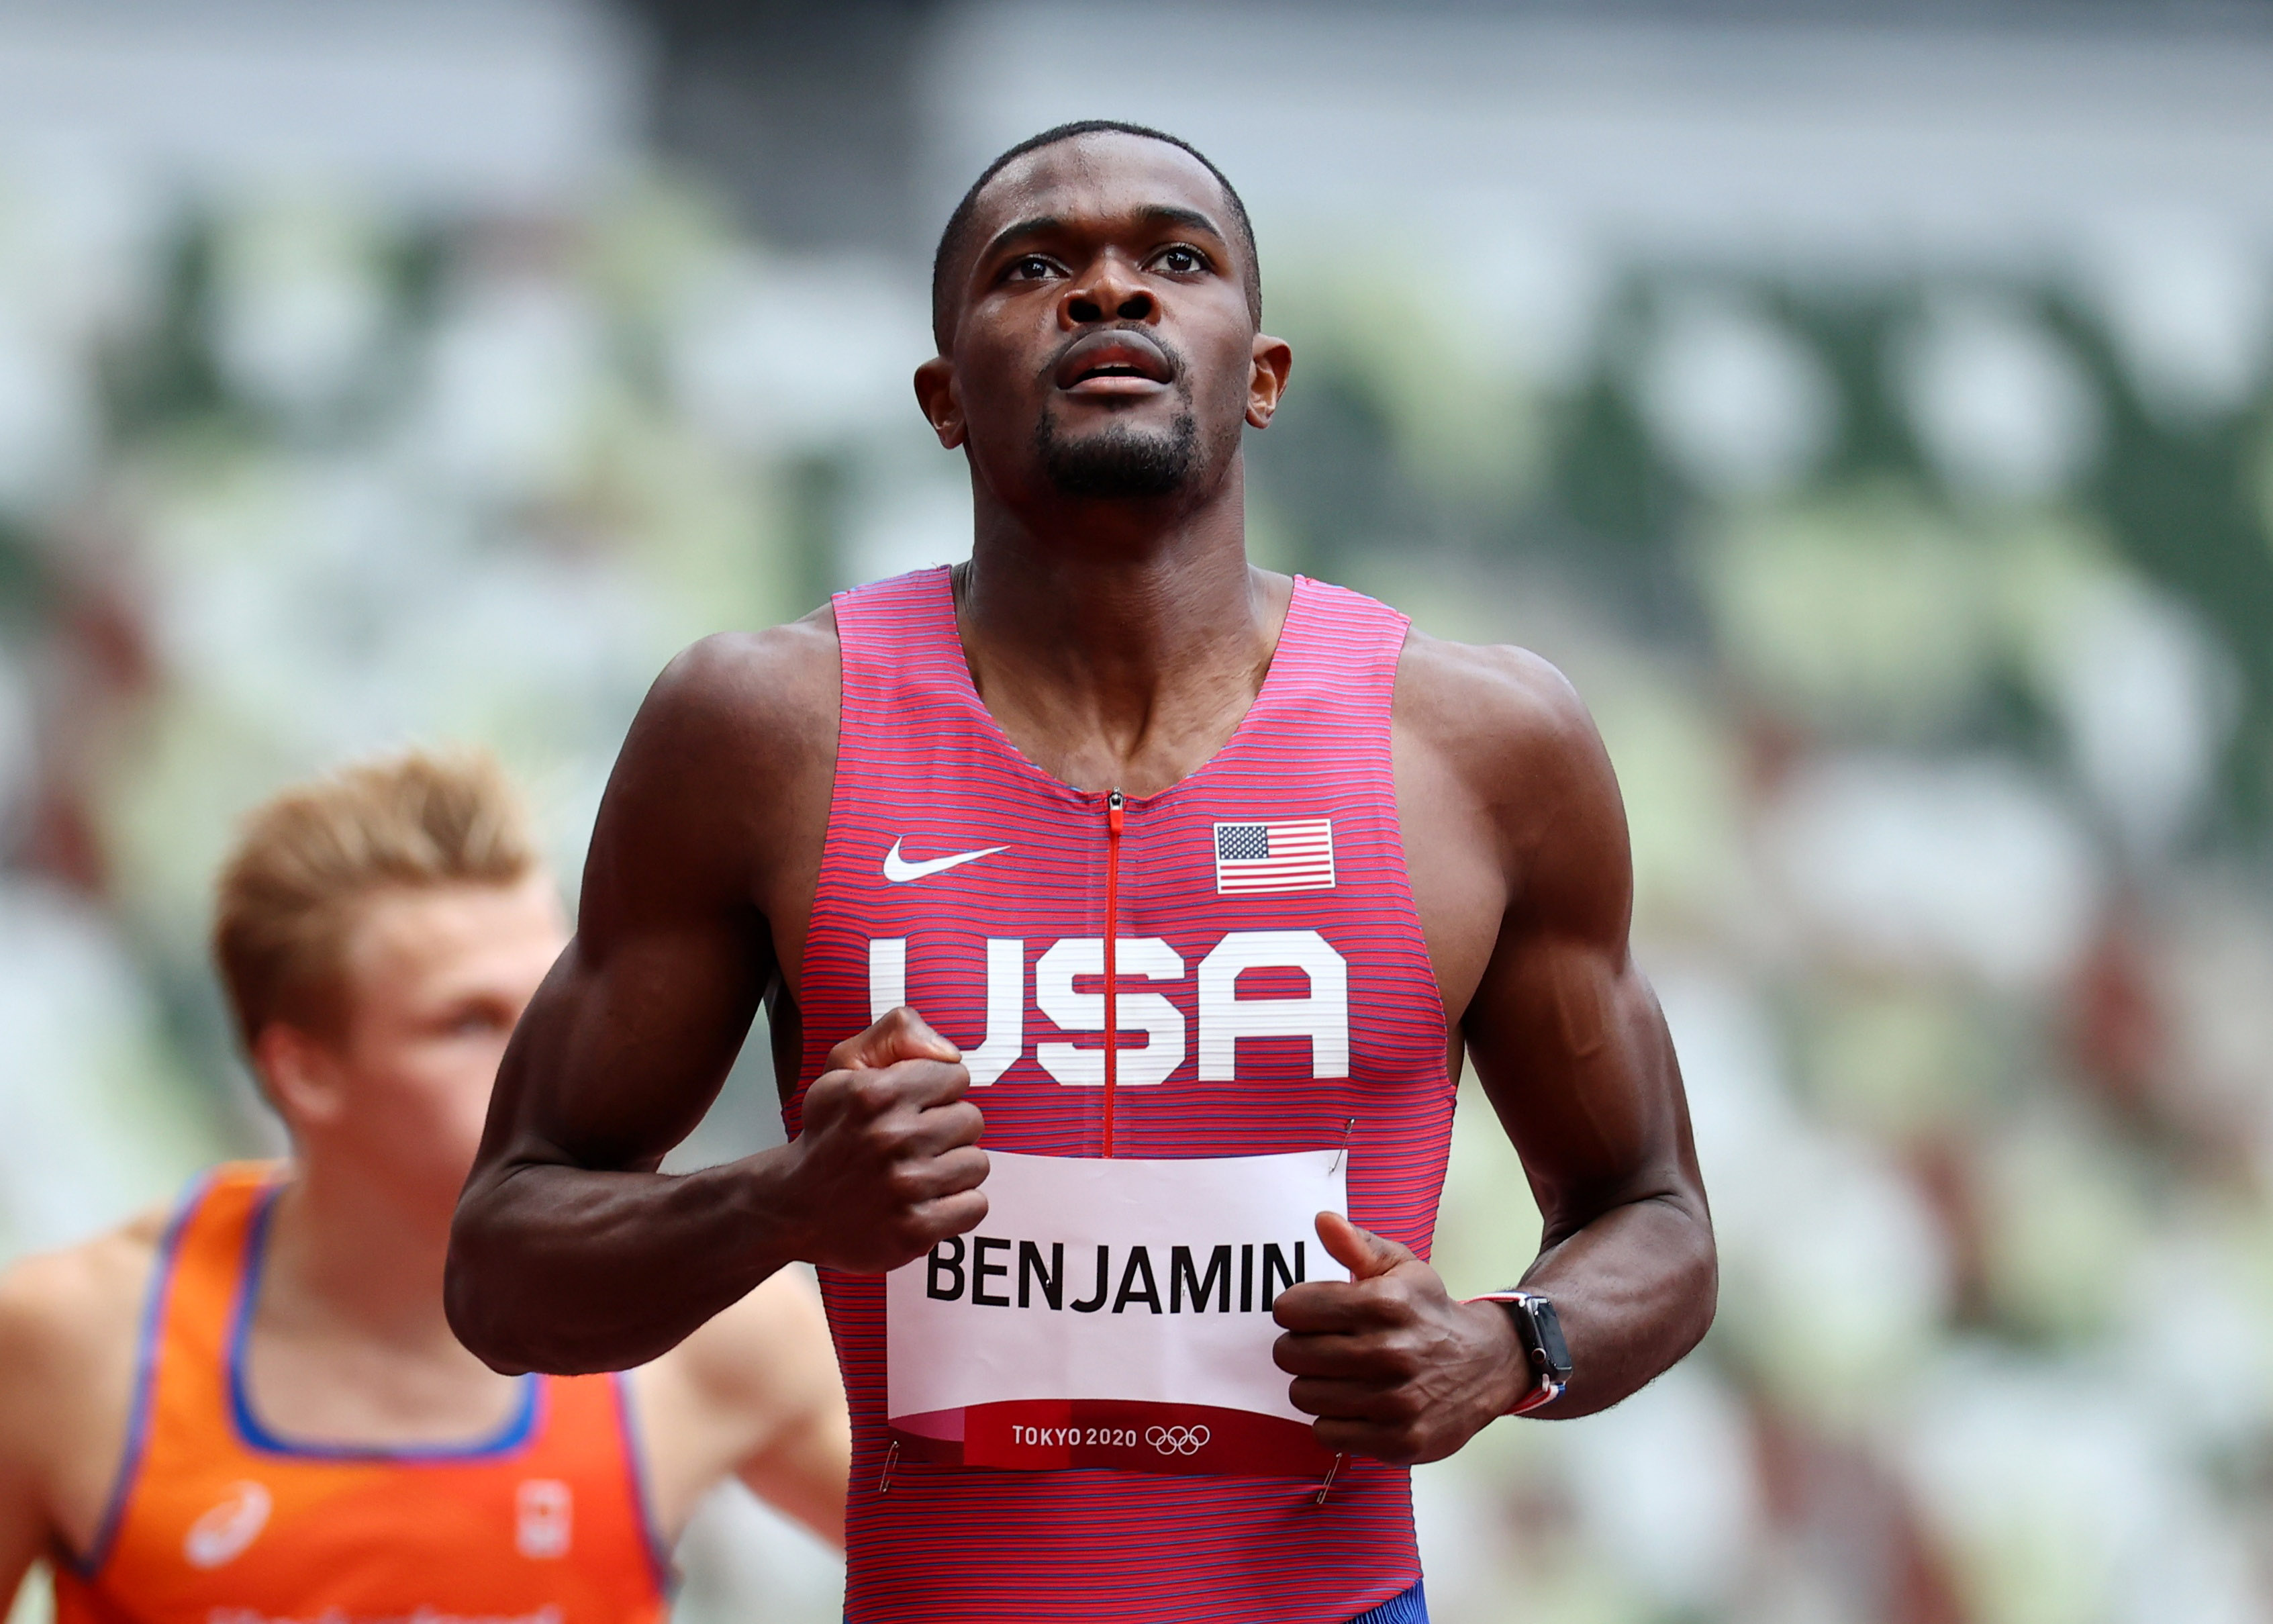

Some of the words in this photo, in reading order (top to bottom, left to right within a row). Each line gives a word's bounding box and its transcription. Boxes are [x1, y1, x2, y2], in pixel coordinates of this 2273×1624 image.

[869, 930, 1349, 1086] USA
[926, 1235, 1306, 1314] BENJAMIN
[1012, 1425, 1080, 1446] TOKYO
[1086, 1429, 1136, 1447] 2020
